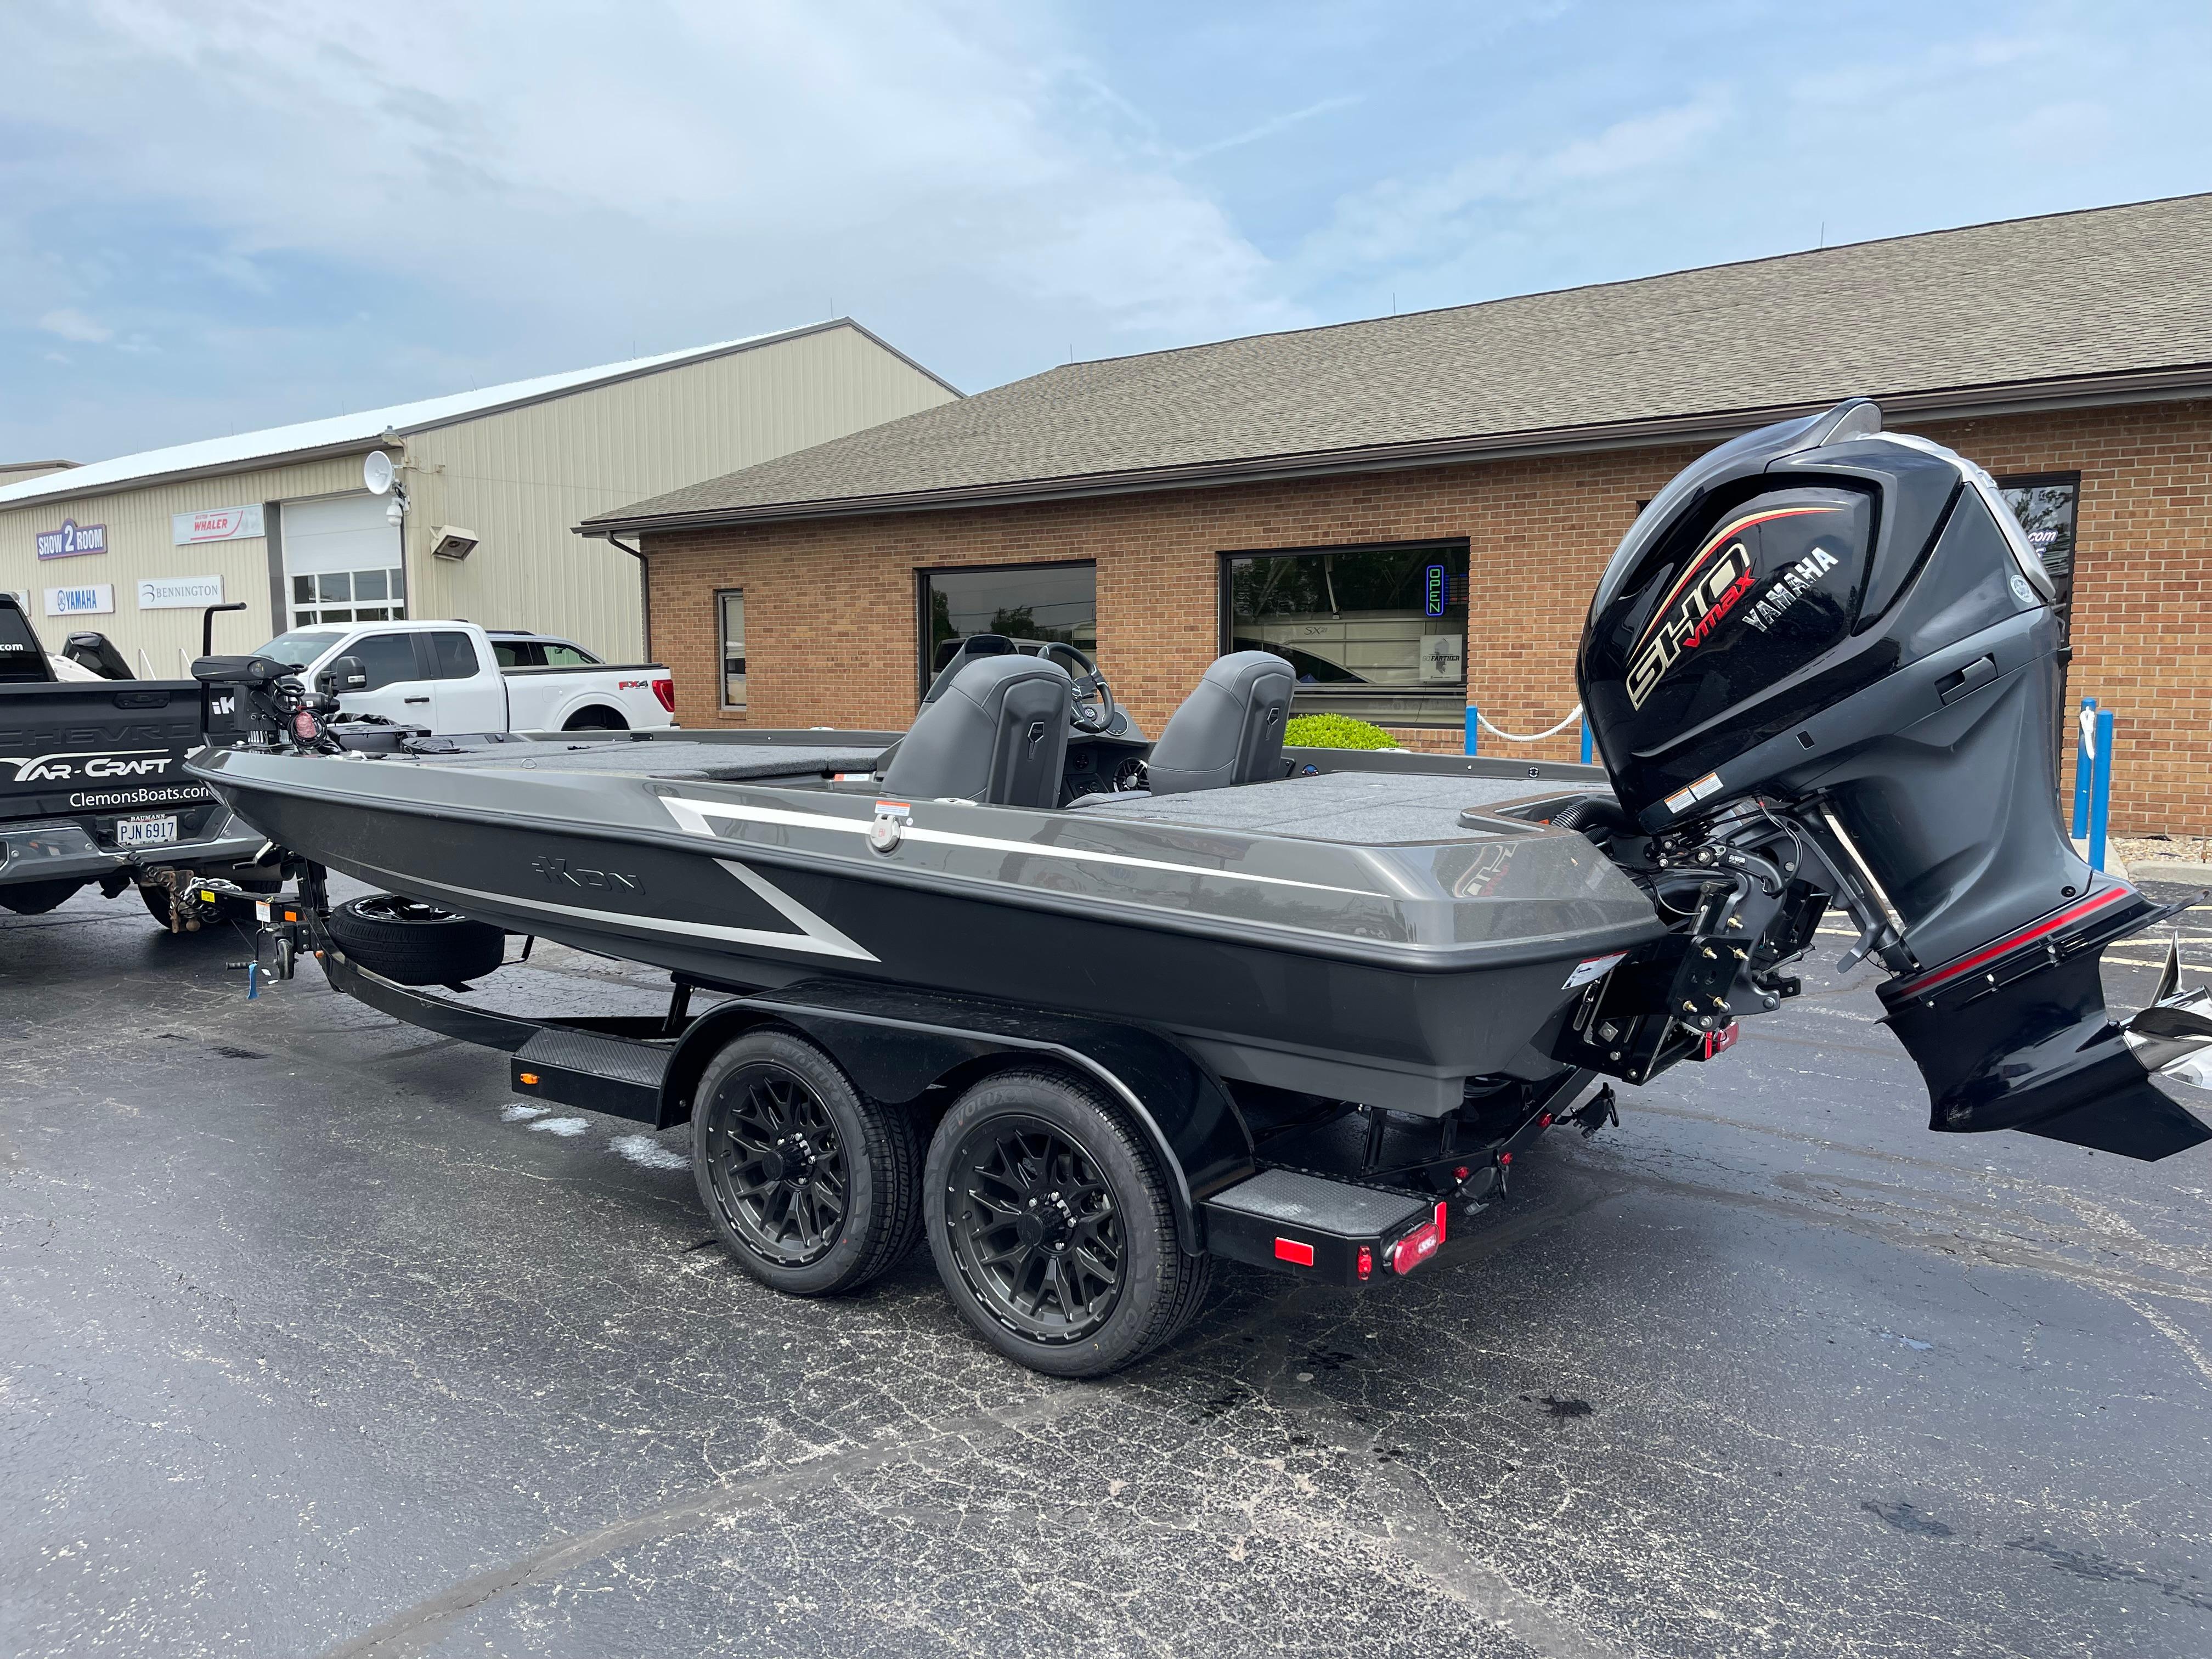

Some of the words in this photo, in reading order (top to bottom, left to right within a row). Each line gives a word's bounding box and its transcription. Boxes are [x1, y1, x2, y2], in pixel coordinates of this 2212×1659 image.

[194, 518, 228, 532] WHALER
[38, 534, 62, 555] SHOW
[65, 524, 74, 552] 2
[76, 528, 103, 550] ROOM
[156, 585, 218, 598] BENNINGTON
[1430, 568, 1441, 613] OPEN
[1741, 547, 1838, 633] YAMAHA
[65, 590, 97, 610] YAMAHA
[618, 680, 648, 690] FX4
[121, 825, 142, 840] PJN
[146, 822, 174, 838] 6917
